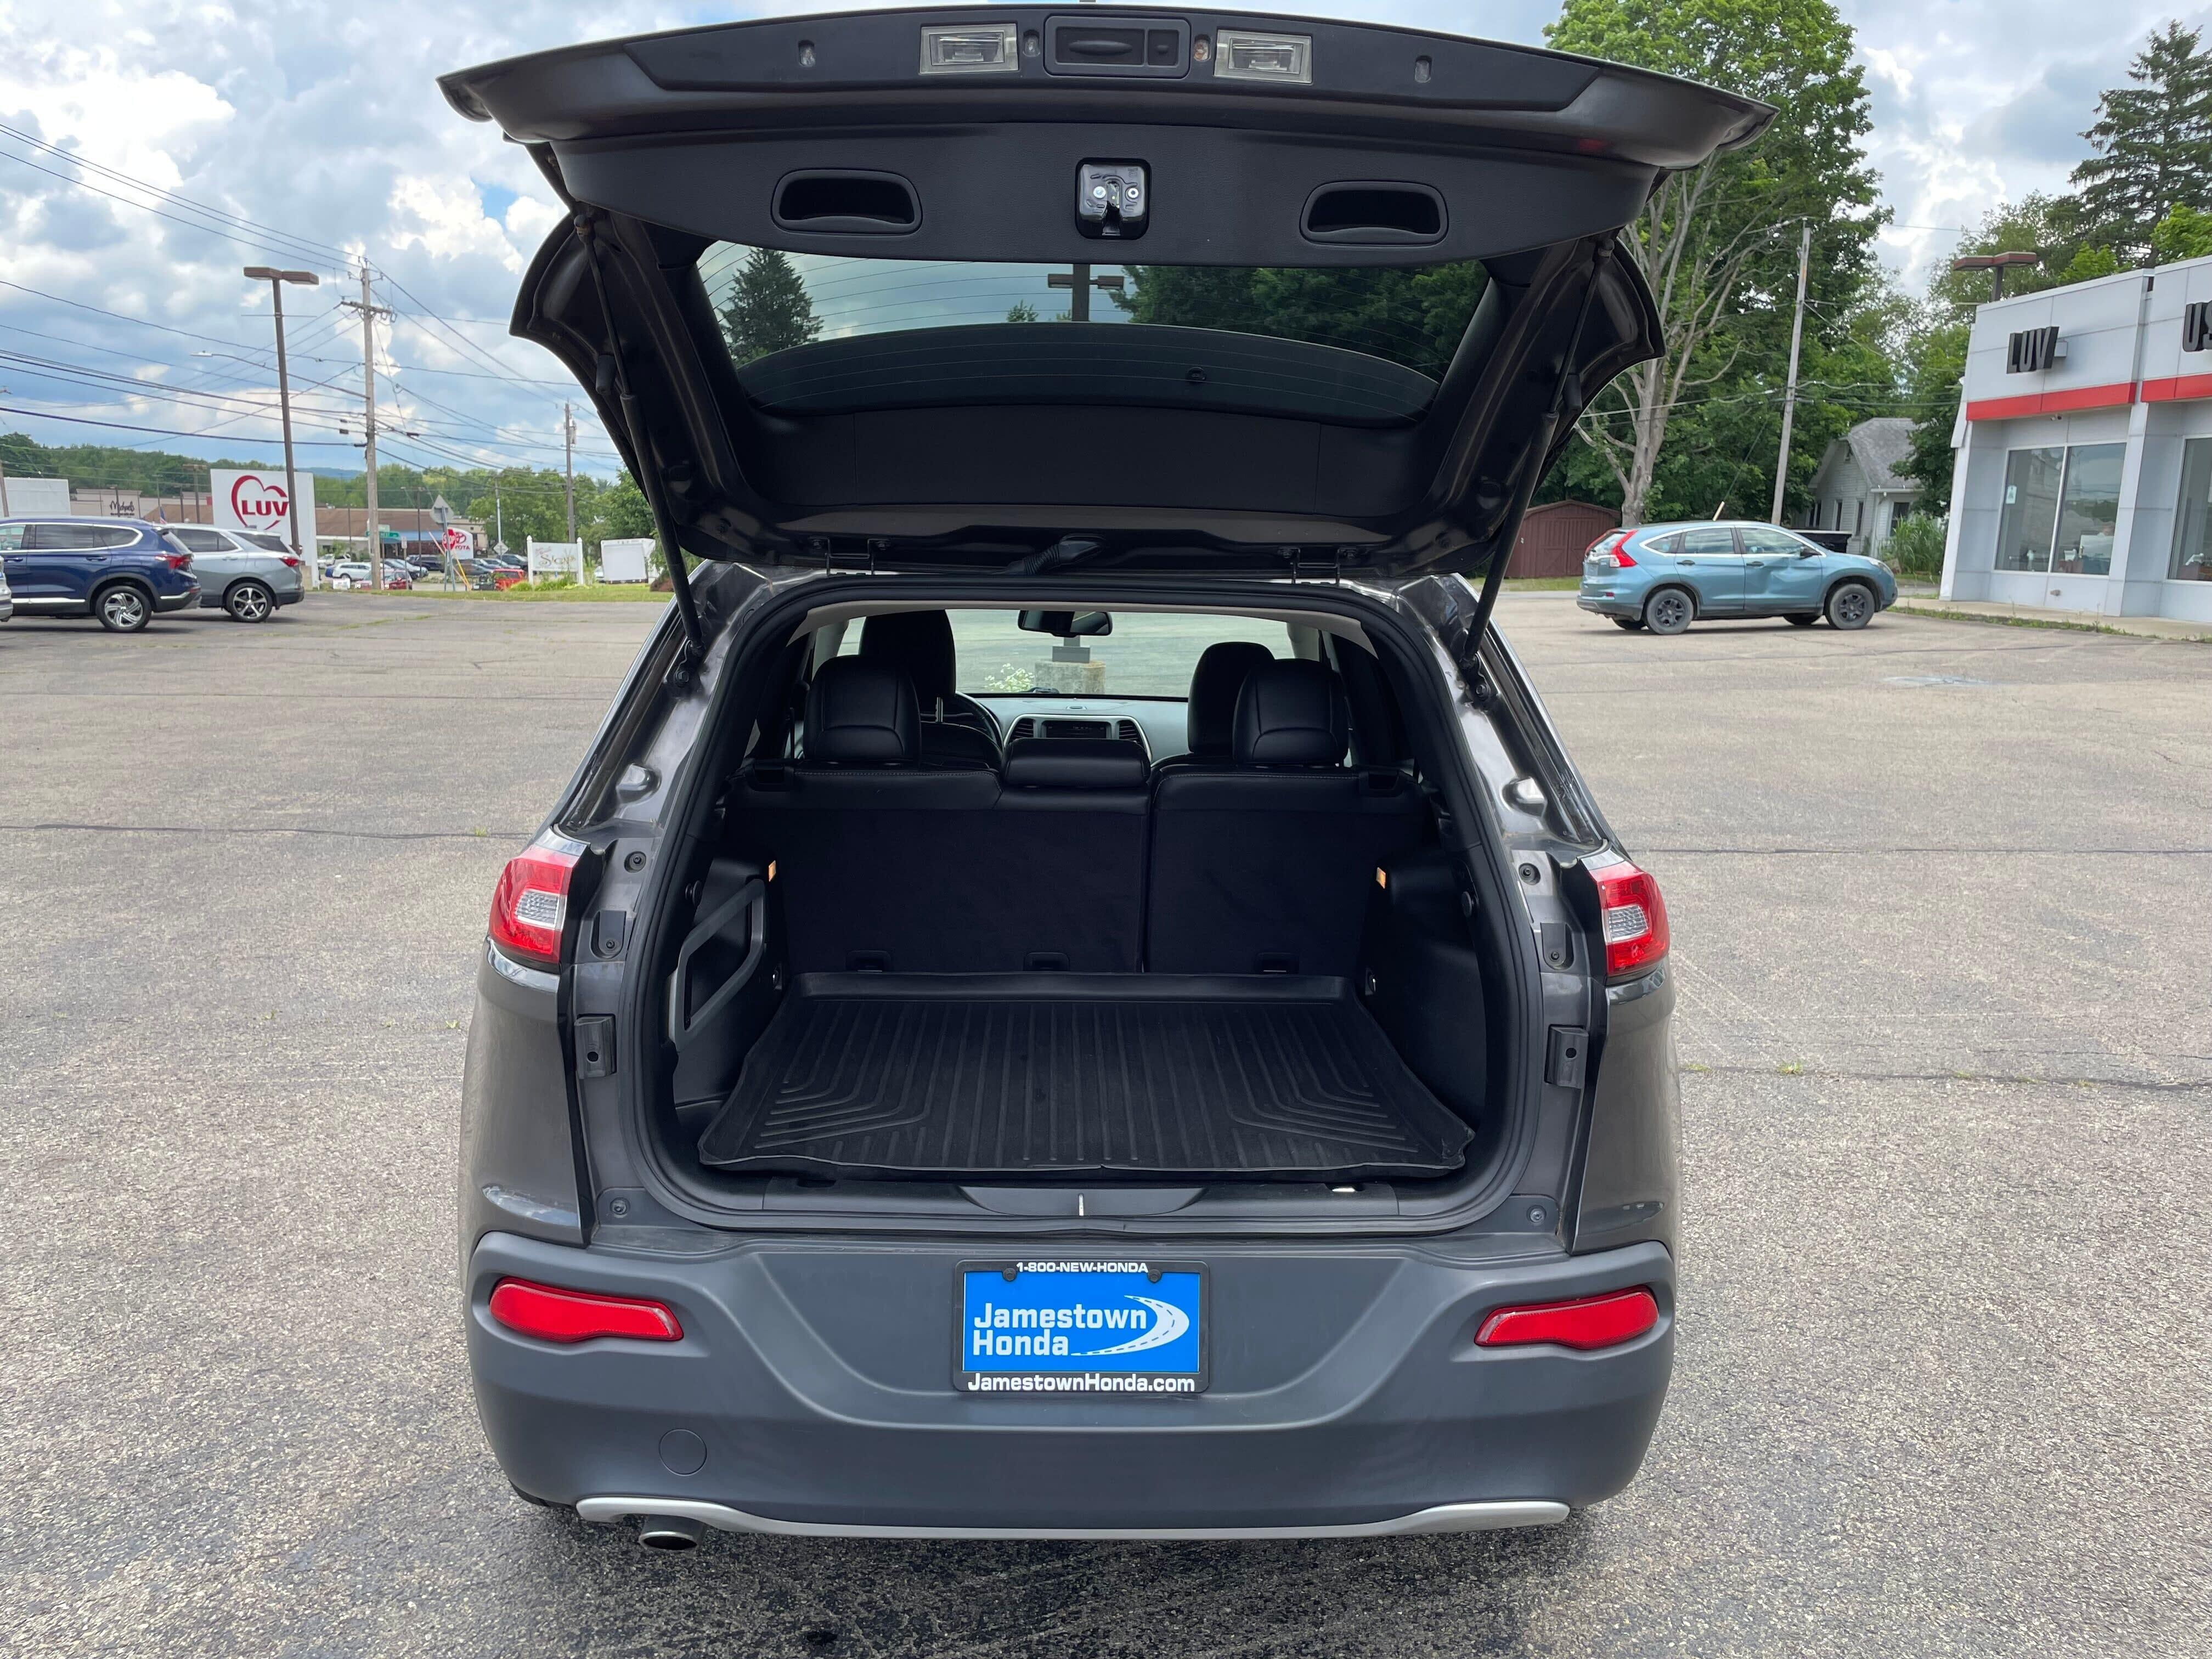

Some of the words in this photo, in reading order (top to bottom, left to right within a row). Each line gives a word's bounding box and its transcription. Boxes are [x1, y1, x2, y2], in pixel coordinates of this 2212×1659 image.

[2006, 326, 2058, 374] LUV
[242, 500, 289, 516] LUV
[1016, 1262, 1149, 1273] 1-800-NEW-HONDA
[974, 1302, 1147, 1329] Jamestown
[973, 1328, 1069, 1356] Honda
[967, 1373, 1195, 1392] JamestownHonda.com
